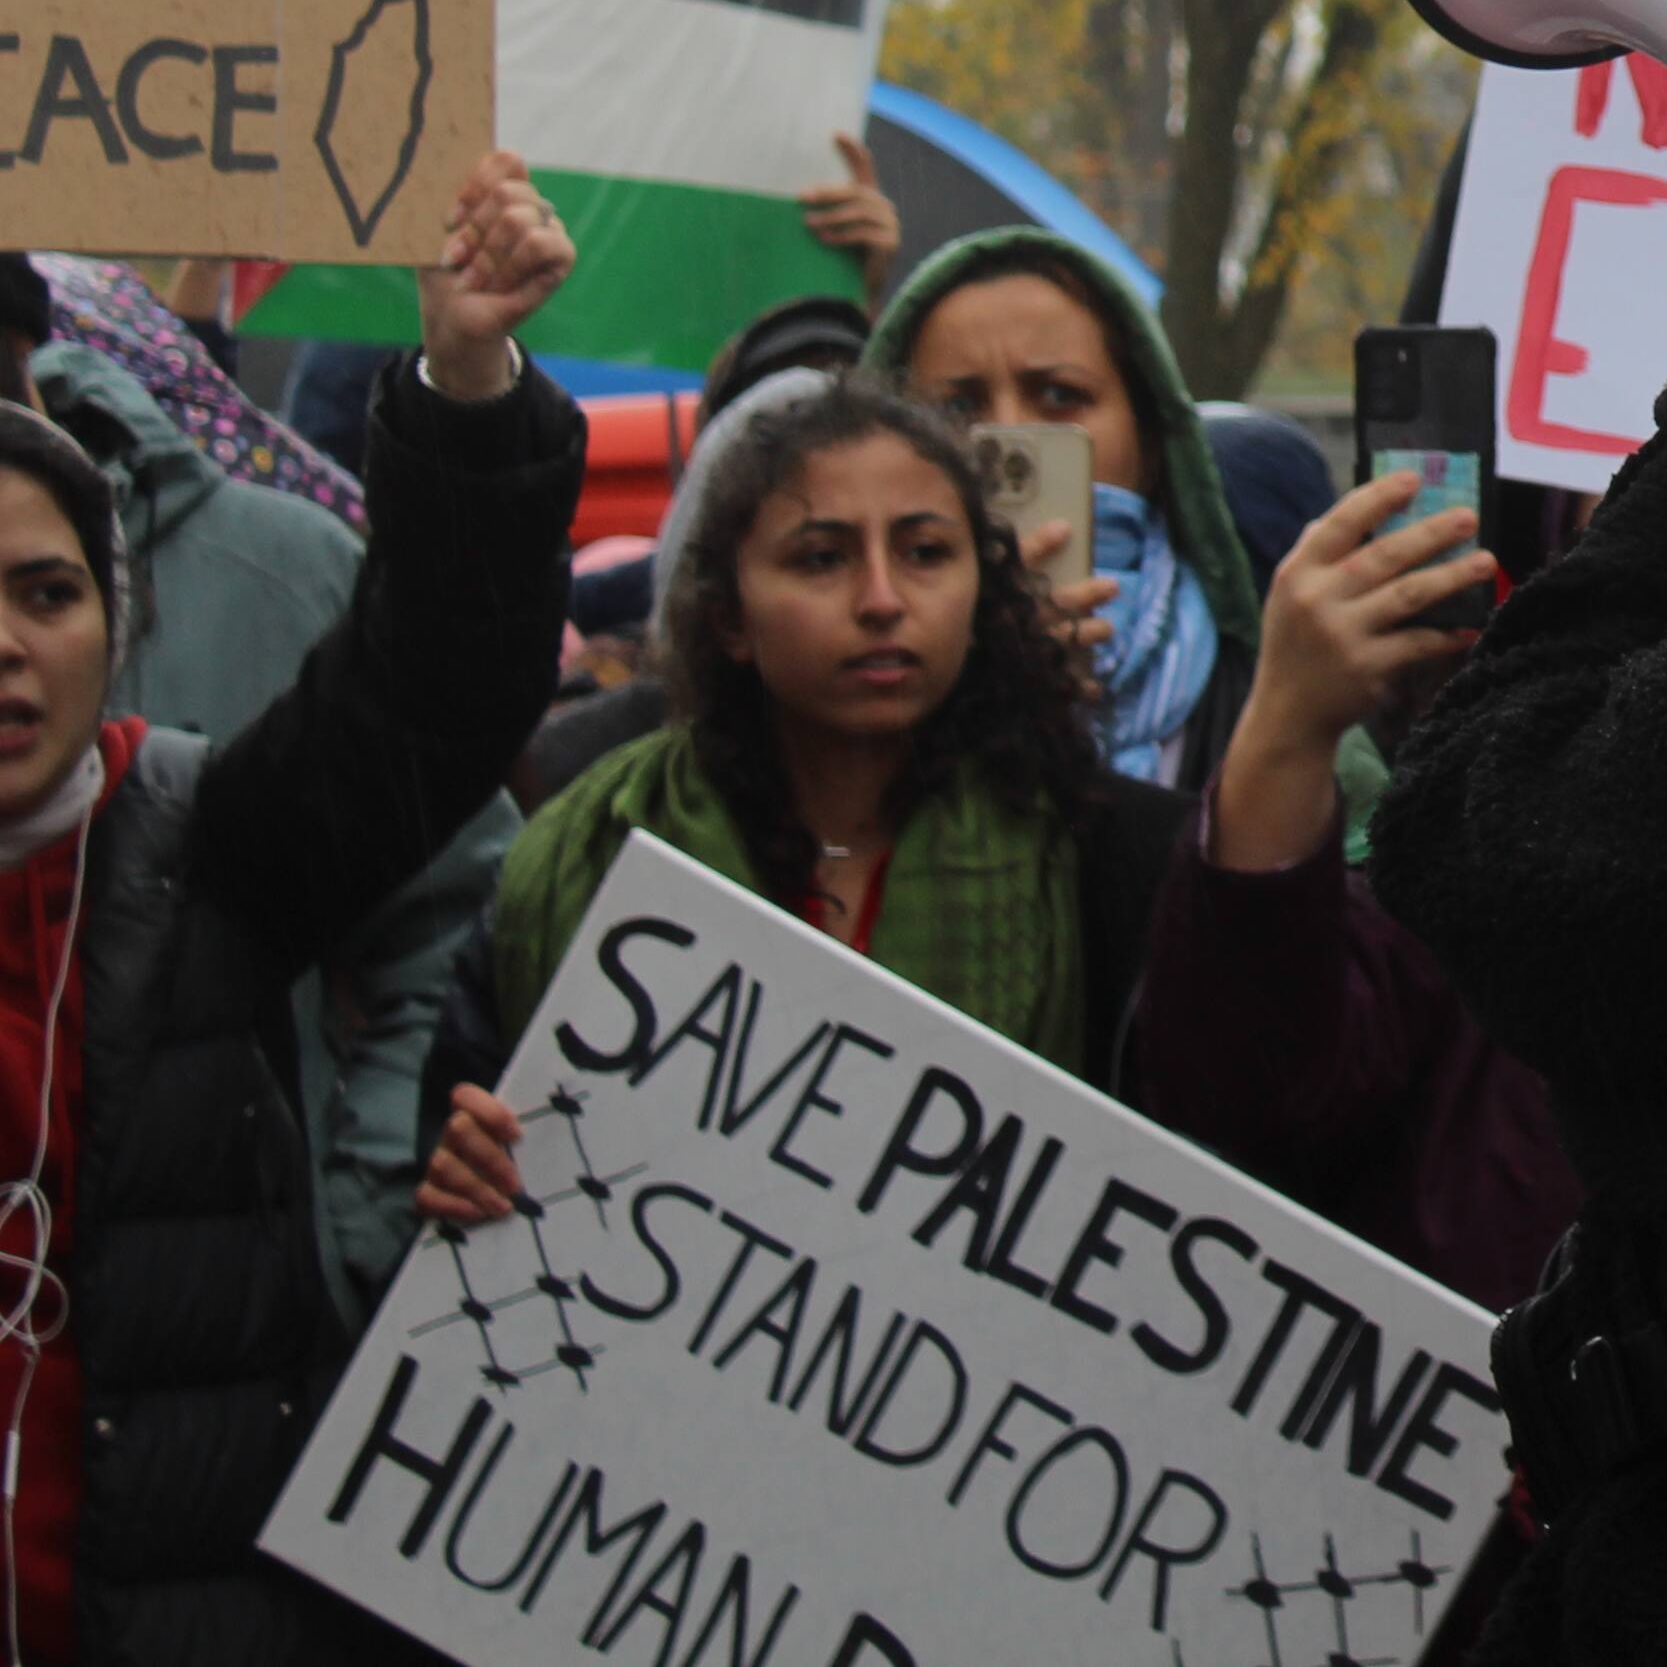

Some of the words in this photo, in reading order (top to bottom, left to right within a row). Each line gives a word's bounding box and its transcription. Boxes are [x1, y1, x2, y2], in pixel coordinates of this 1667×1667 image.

[553, 916, 896, 1190] SAVE
[856, 1065, 1503, 1522] PALESTINE
[578, 1183, 968, 1468] STAND
[946, 1380, 1228, 1633] FOR
[326, 1352, 800, 1667] HUMAN
